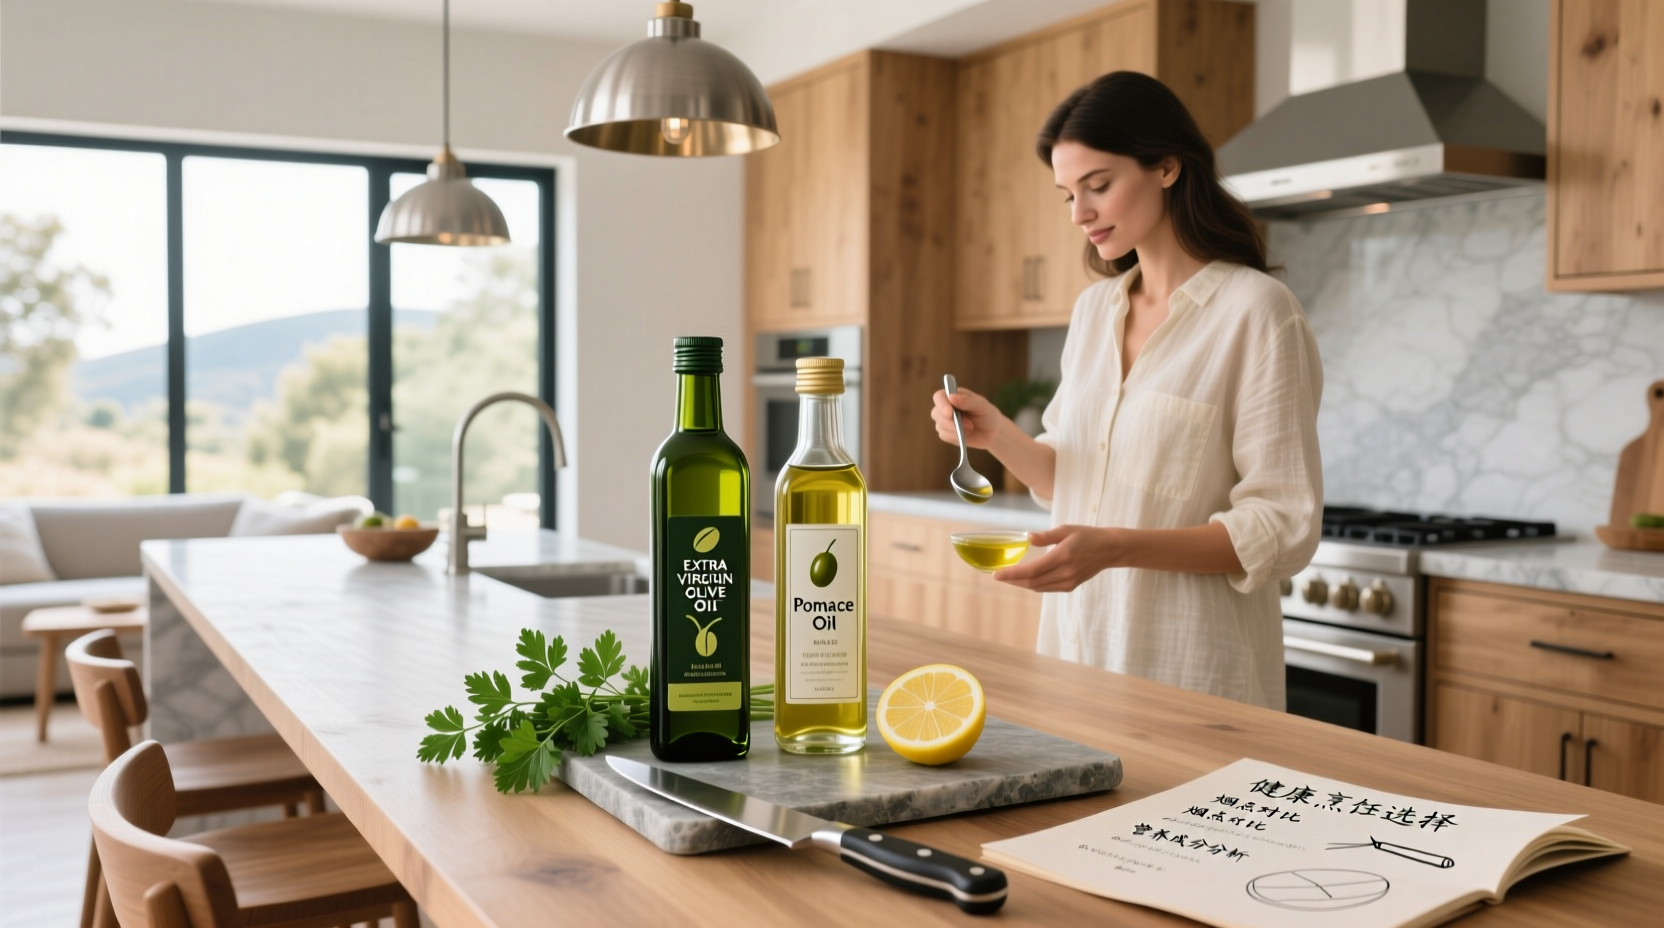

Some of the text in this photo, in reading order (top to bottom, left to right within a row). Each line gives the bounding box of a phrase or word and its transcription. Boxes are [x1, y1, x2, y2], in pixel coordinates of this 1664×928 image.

[683, 559, 728, 571] EXTRA
[793, 597, 855, 613] Pomace
[812, 615, 837, 631] Oil
